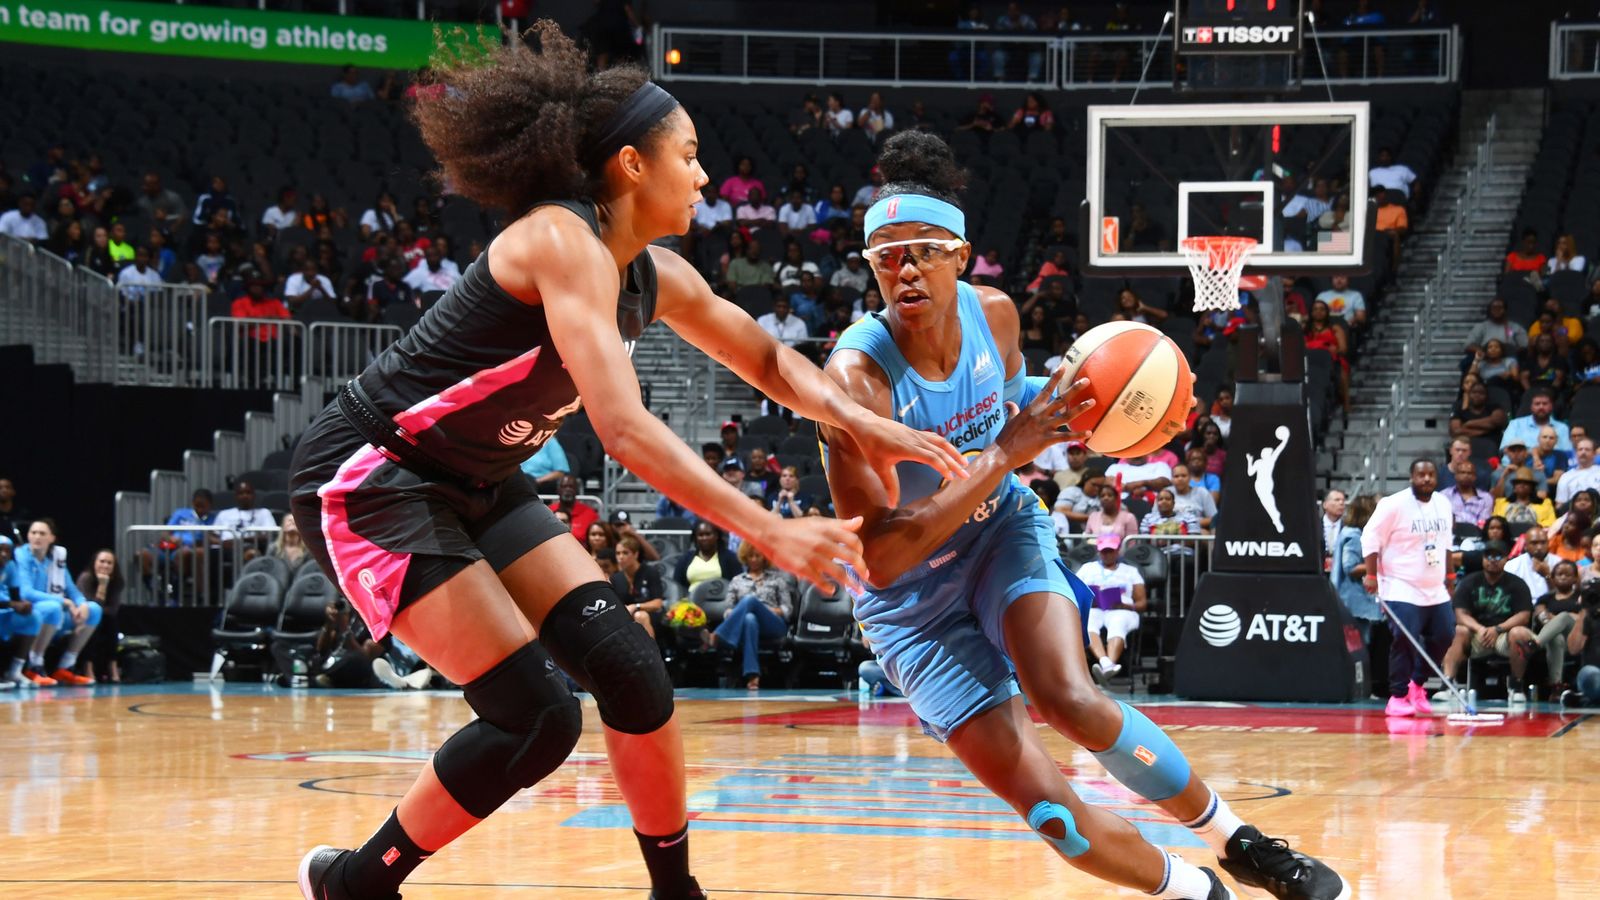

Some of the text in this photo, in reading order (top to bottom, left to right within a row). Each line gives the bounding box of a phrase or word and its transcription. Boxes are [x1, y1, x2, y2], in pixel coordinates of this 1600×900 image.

[19, 4, 90, 32] team
[100, 10, 140, 37] for
[149, 20, 268, 48] growing
[275, 26, 388, 53] athletes
[1213, 26, 1294, 43] TISSOT
[951, 408, 1001, 448] edicine
[1225, 541, 1304, 557] WNBA
[1245, 613, 1325, 643] AT&T
